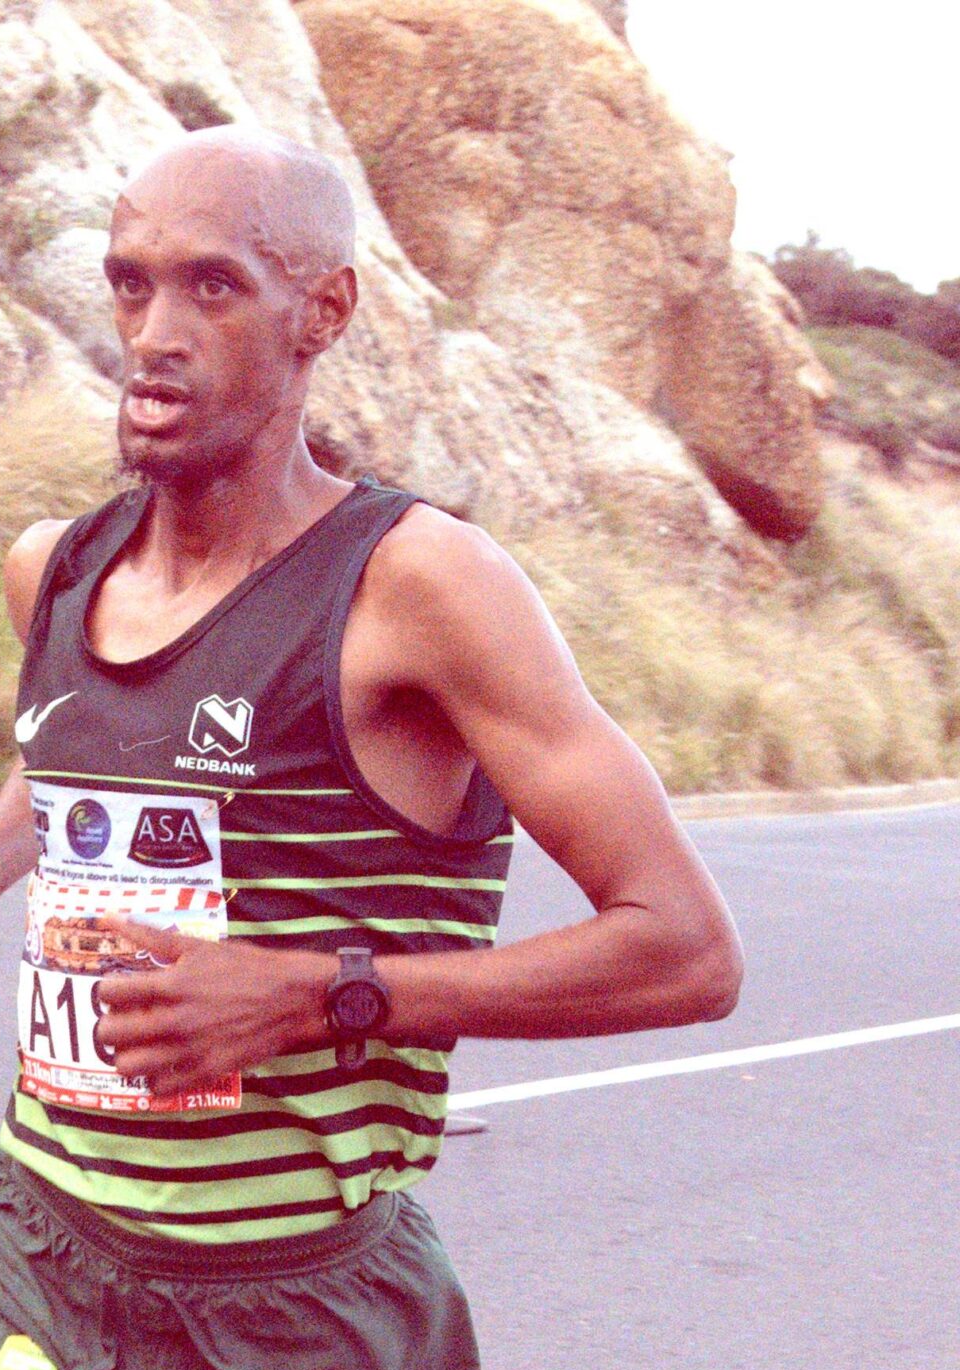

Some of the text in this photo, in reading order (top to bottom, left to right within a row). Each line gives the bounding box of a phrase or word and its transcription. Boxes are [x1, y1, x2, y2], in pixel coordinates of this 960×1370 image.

[175, 755, 256, 776] NEDBANK
[138, 815, 198, 843] ASA
[149, 875, 214, 886] disqualification
[186, 1091, 236, 1108] 21.1km
